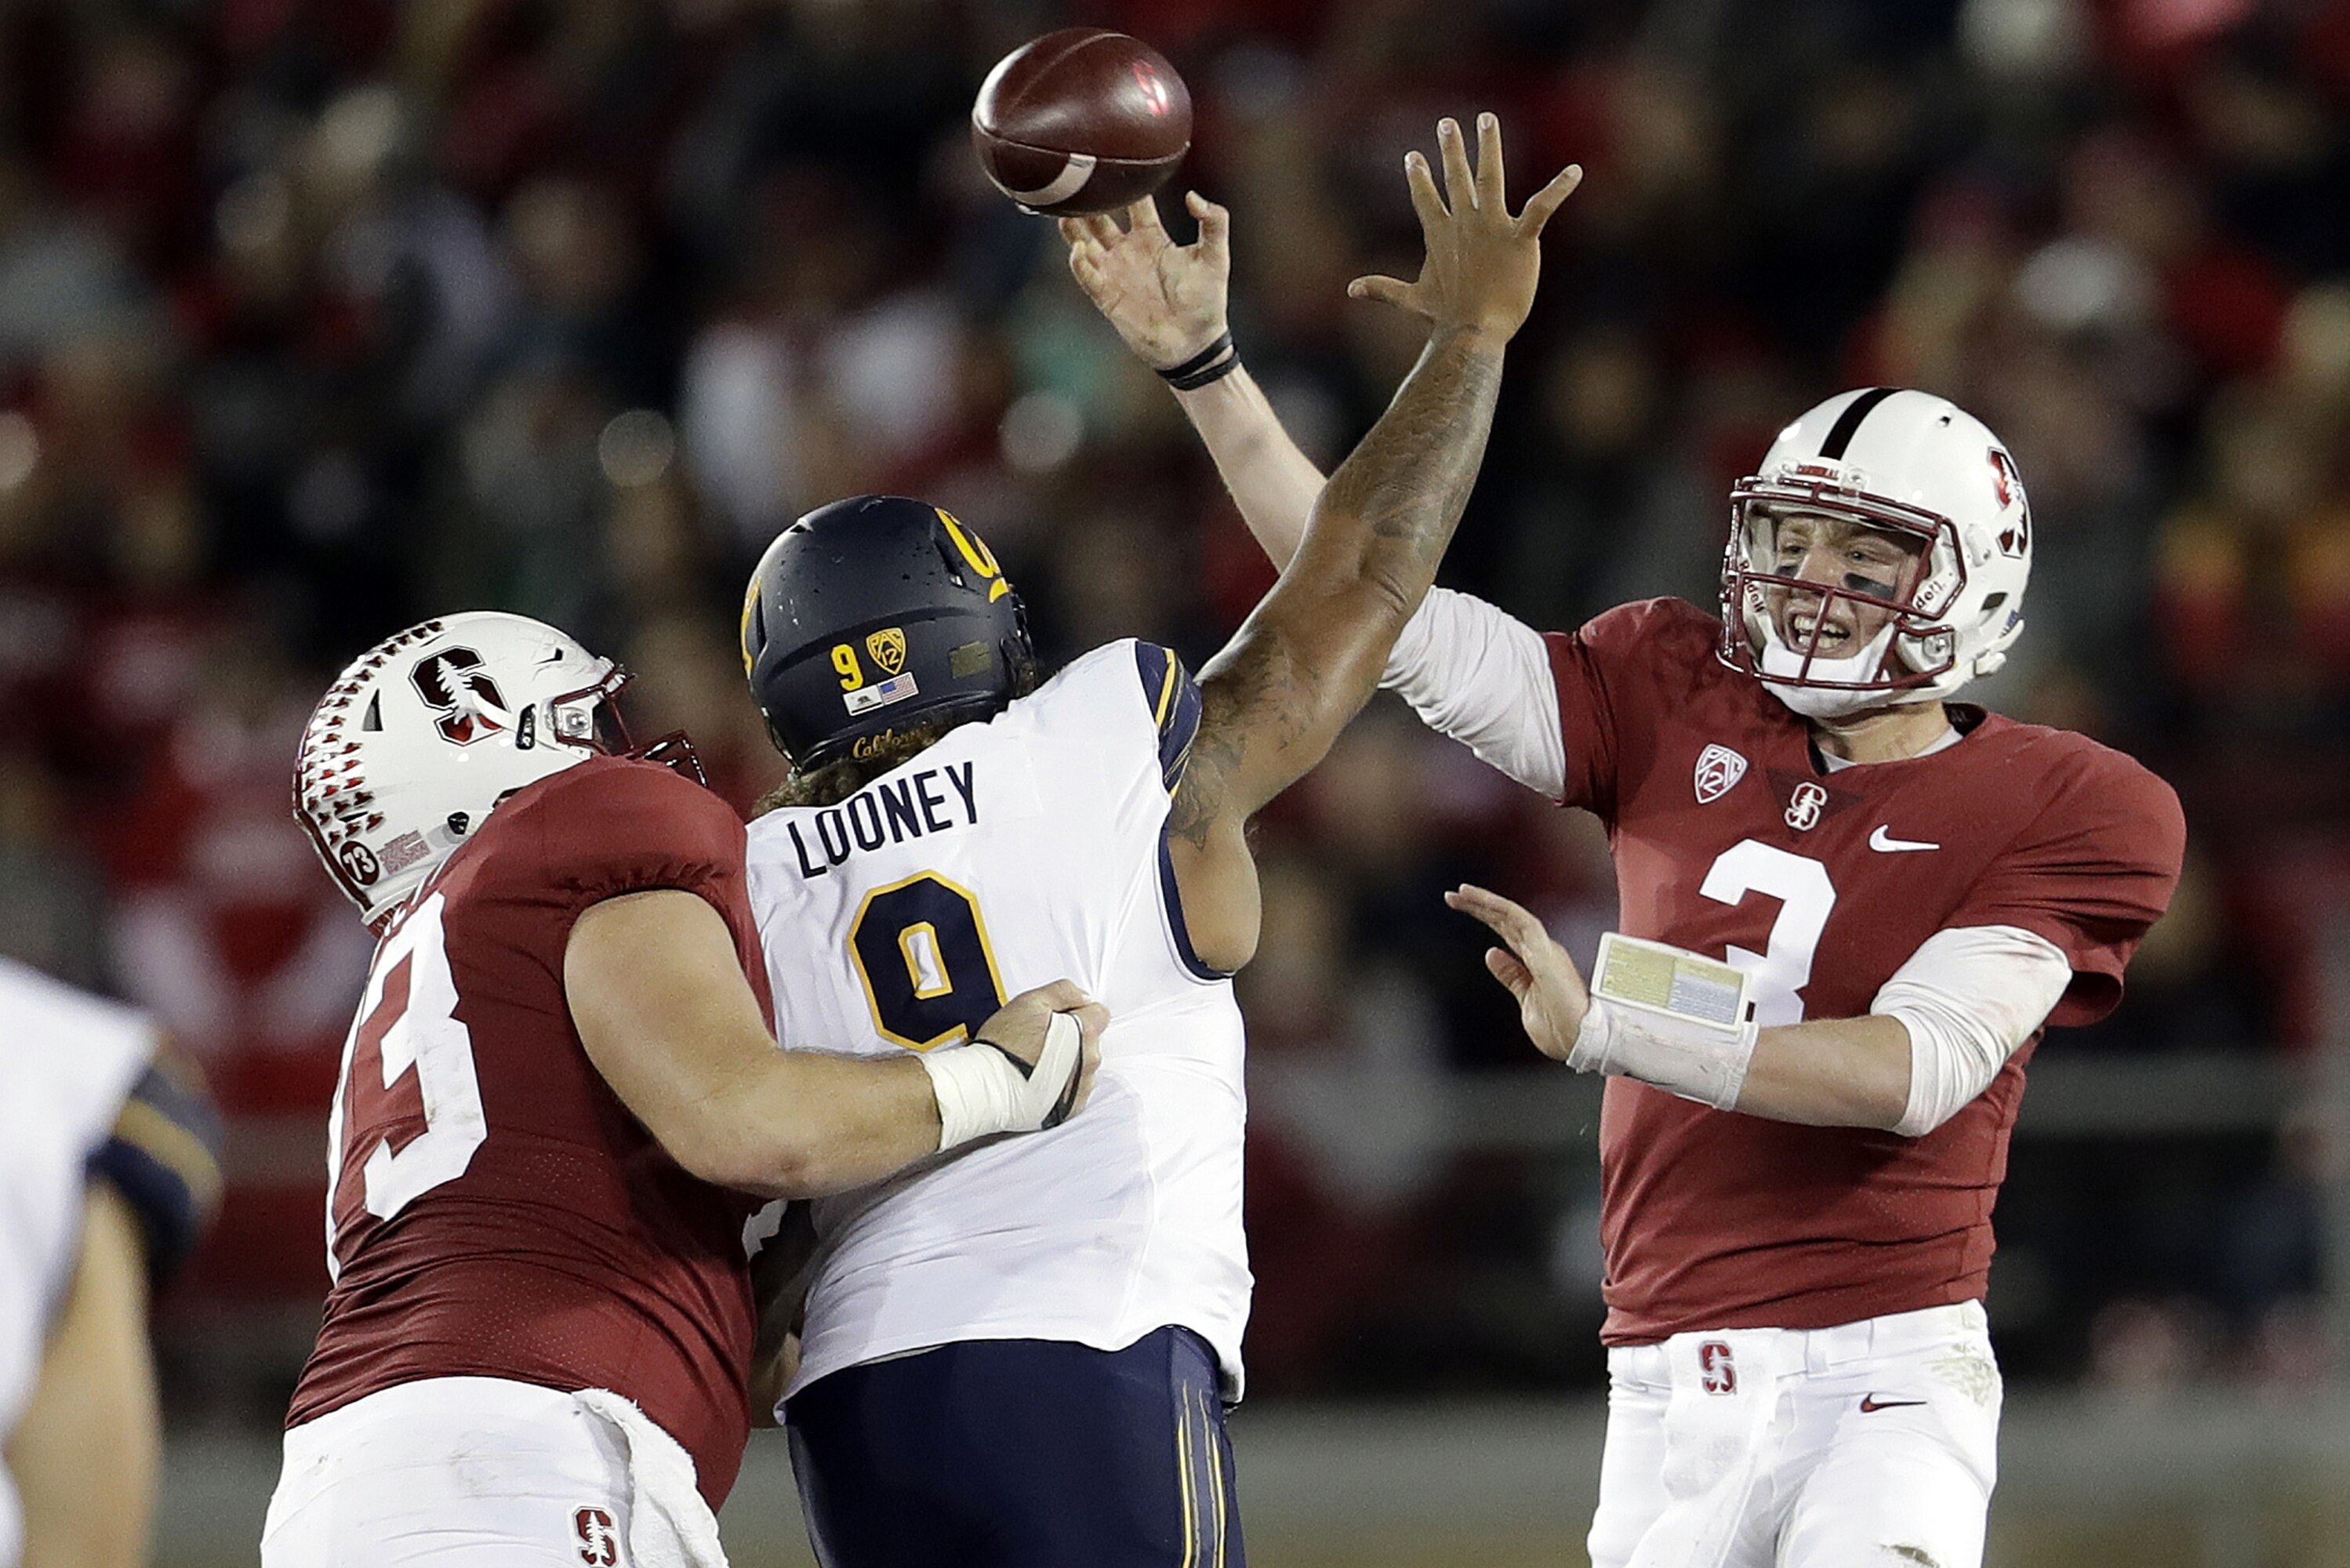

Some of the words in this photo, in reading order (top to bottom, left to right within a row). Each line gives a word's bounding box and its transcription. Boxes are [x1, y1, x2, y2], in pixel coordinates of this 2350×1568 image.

[868, 630, 903, 659] PAC
[881, 648, 900, 666] 12
[830, 644, 863, 691] 9
[1698, 747, 1743, 787] PAC
[1698, 768, 1724, 794] 12
[787, 760, 978, 880] LOONEY
[342, 846, 376, 881] 73
[846, 869, 1009, 1052] 9
